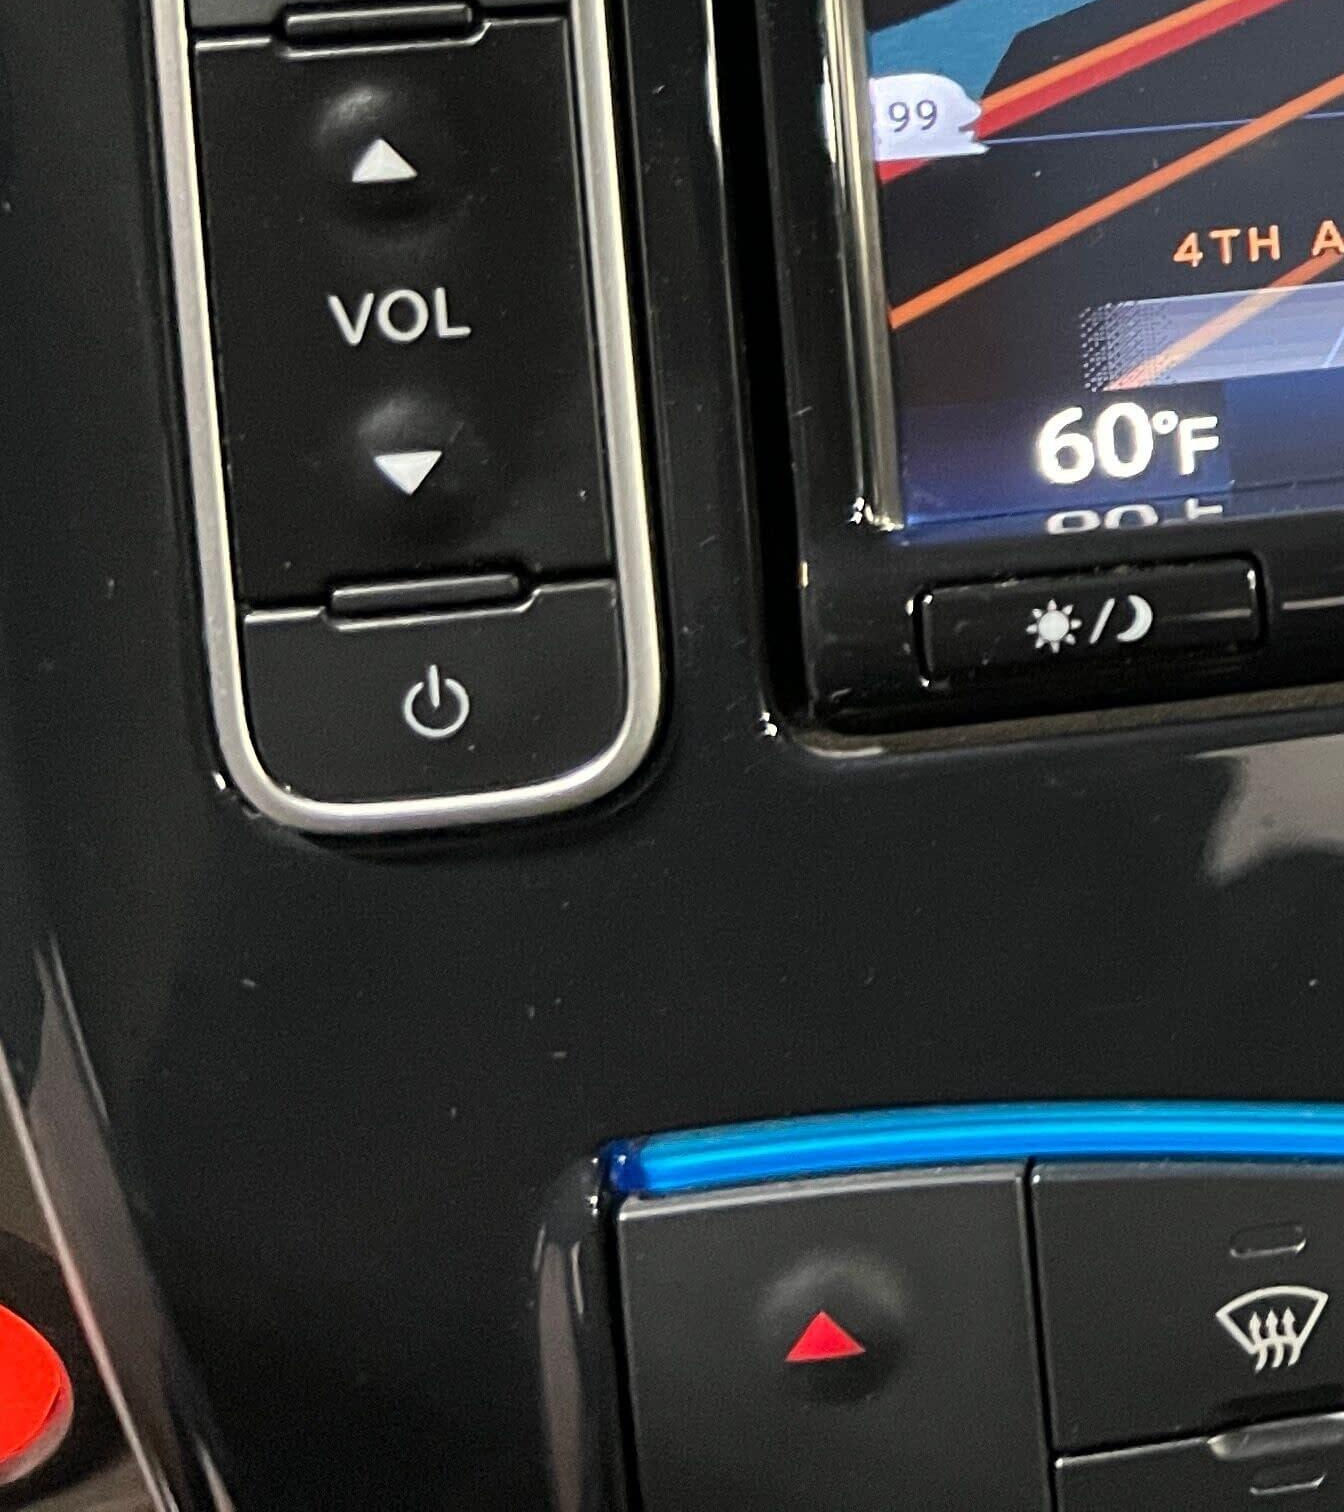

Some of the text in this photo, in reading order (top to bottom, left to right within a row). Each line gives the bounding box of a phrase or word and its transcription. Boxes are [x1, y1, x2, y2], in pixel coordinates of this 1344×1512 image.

[888, 99, 938, 133] 99
[1172, 224, 1281, 268] 4TH
[328, 288, 471, 346] VOL
